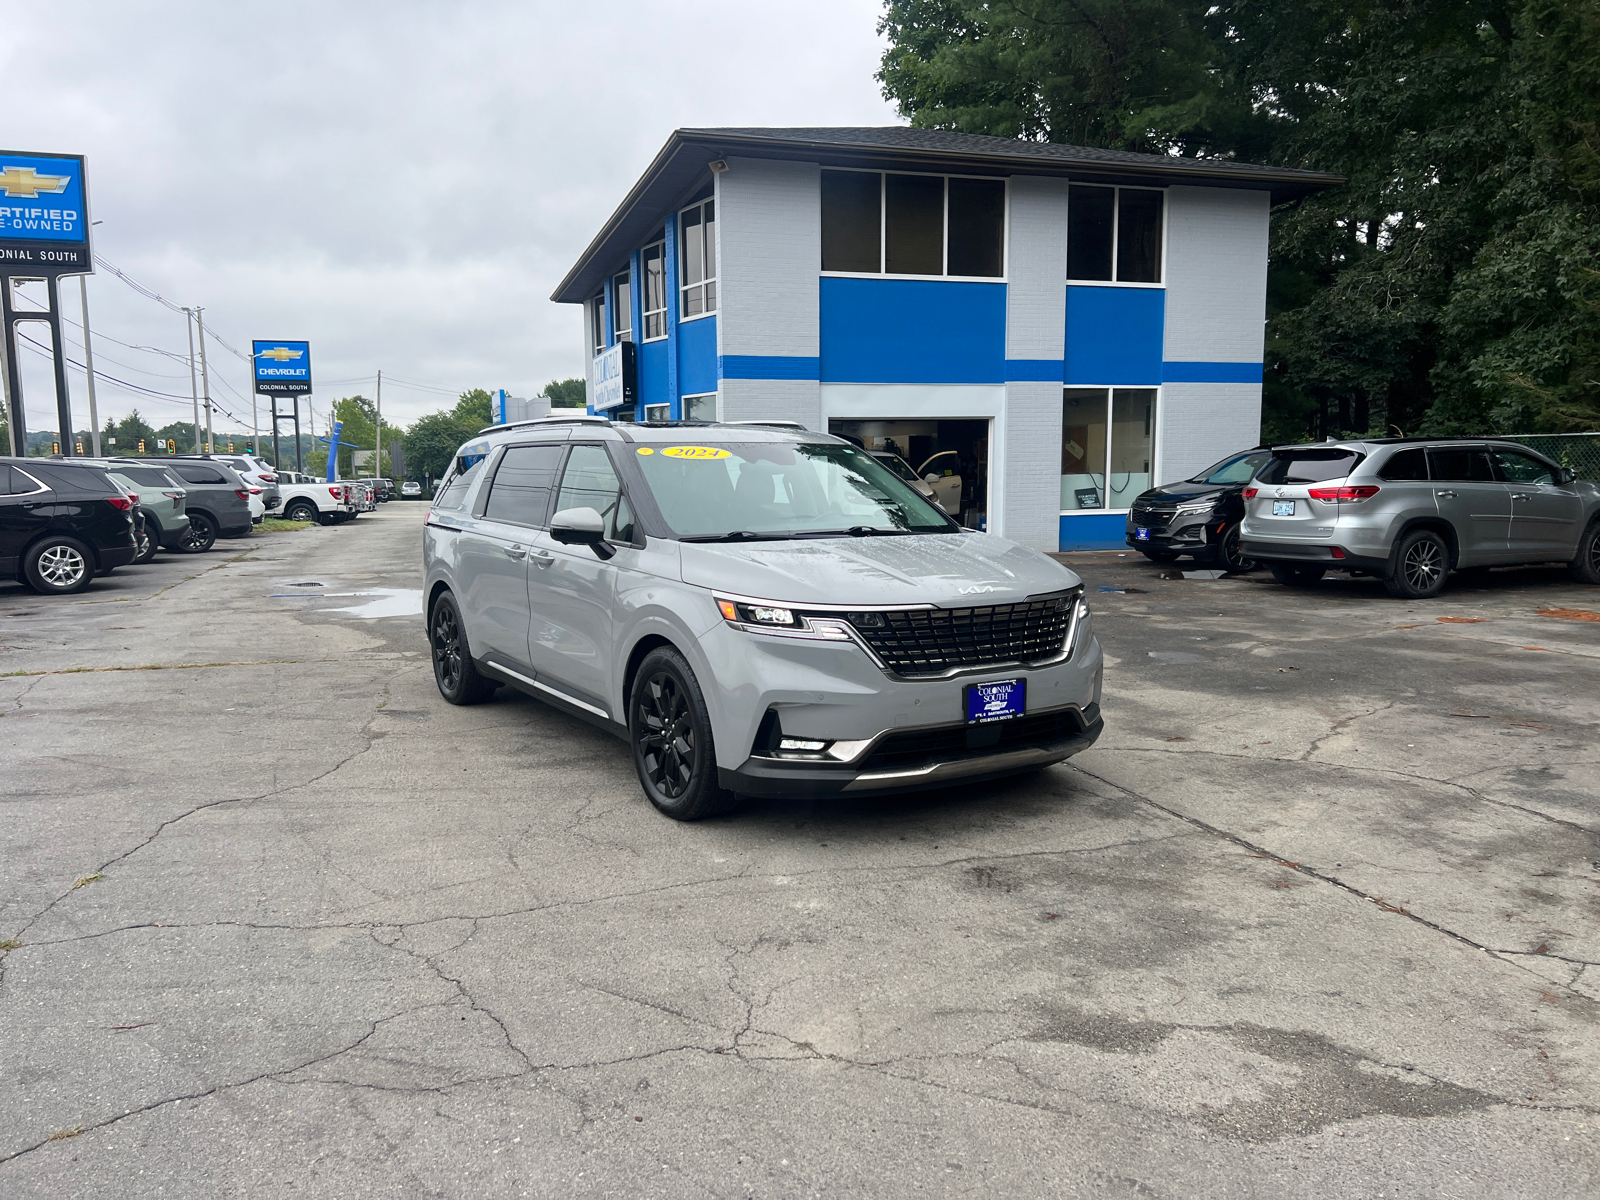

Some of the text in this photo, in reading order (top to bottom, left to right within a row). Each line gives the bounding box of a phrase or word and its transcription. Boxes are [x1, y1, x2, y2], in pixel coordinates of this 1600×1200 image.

[40, 251, 77, 261] SOUTH
[673, 448, 721, 457] 2024
[978, 685, 1014, 696] COLONIAL
[983, 692, 1008, 703] SOUTH
